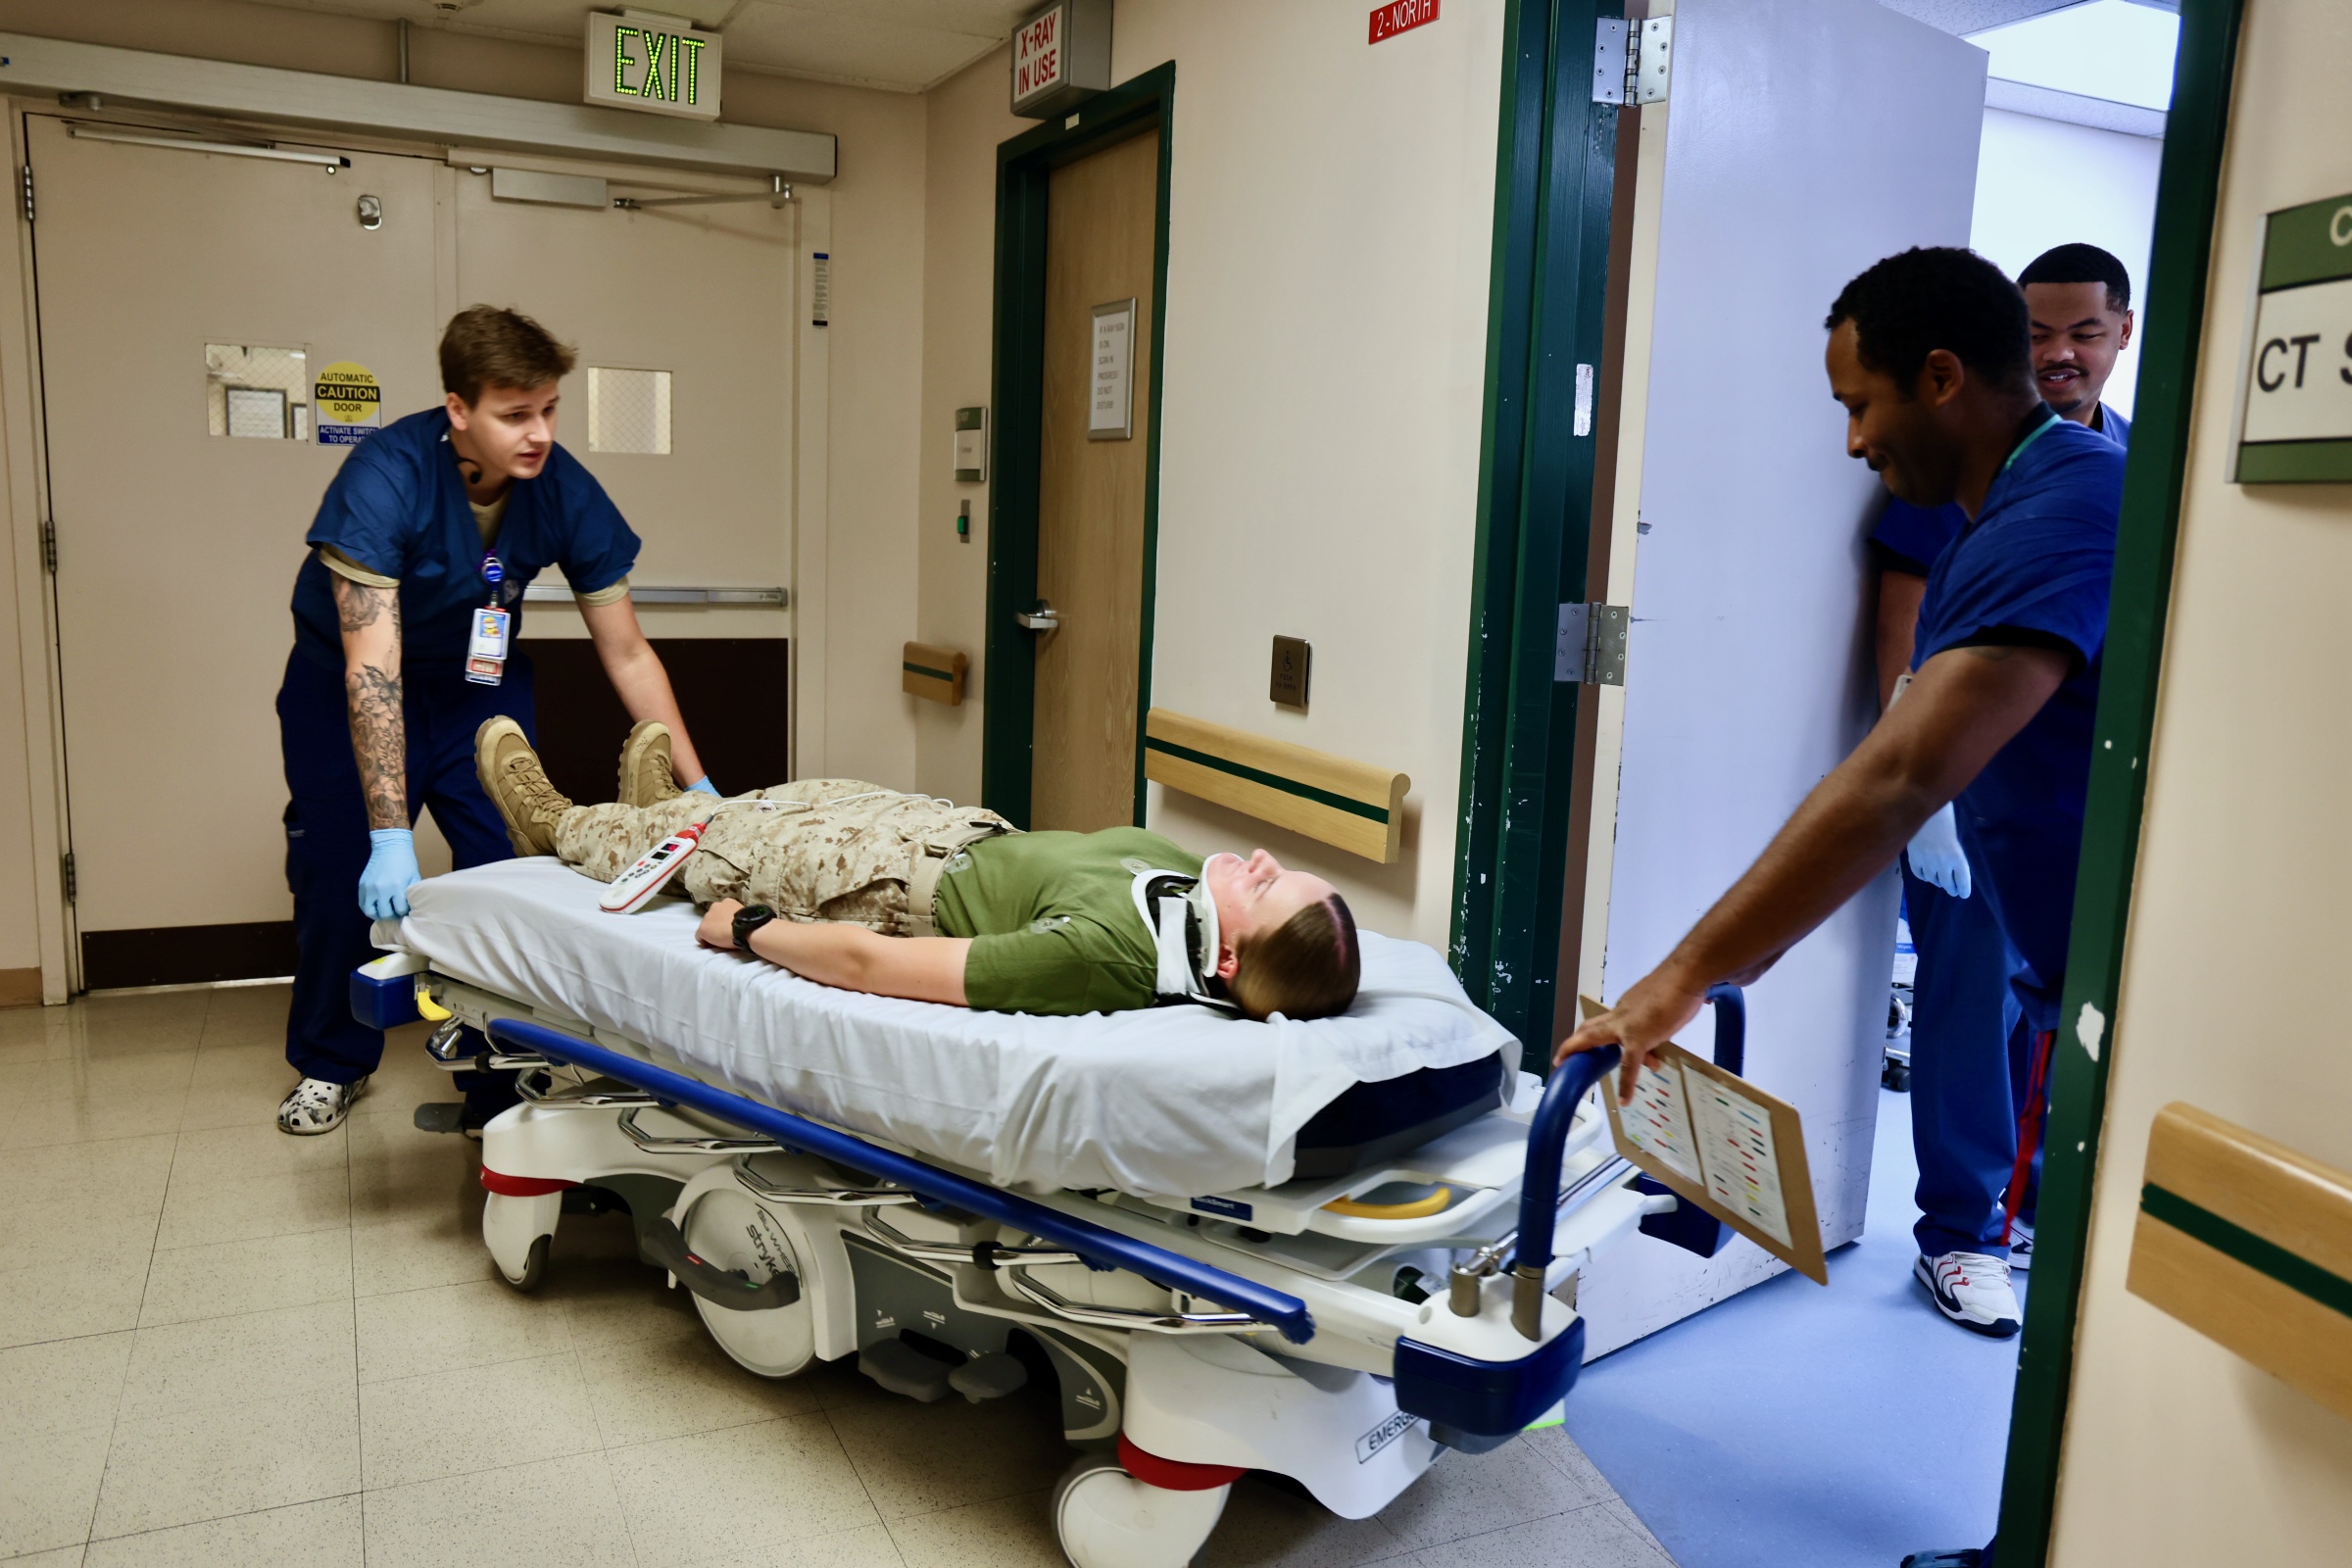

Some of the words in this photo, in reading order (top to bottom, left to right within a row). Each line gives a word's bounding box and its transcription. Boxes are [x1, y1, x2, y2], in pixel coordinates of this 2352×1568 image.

[1021, 12, 1056, 60] X-RAY
[614, 24, 706, 105] EXIT
[1019, 64, 1030, 95] IN
[1034, 48, 1056, 87] USE
[320, 372, 373, 383] AUTOMATIC
[2257, 333, 2321, 393] CT
[317, 385, 377, 401] CAUTION
[333, 402, 363, 412] DOOR
[319, 426, 352, 435] ACTIVATE
[746, 1224, 780, 1279] stryke
[769, 1231, 797, 1275] WHEE
[1368, 1412, 1414, 1451] EMERG
